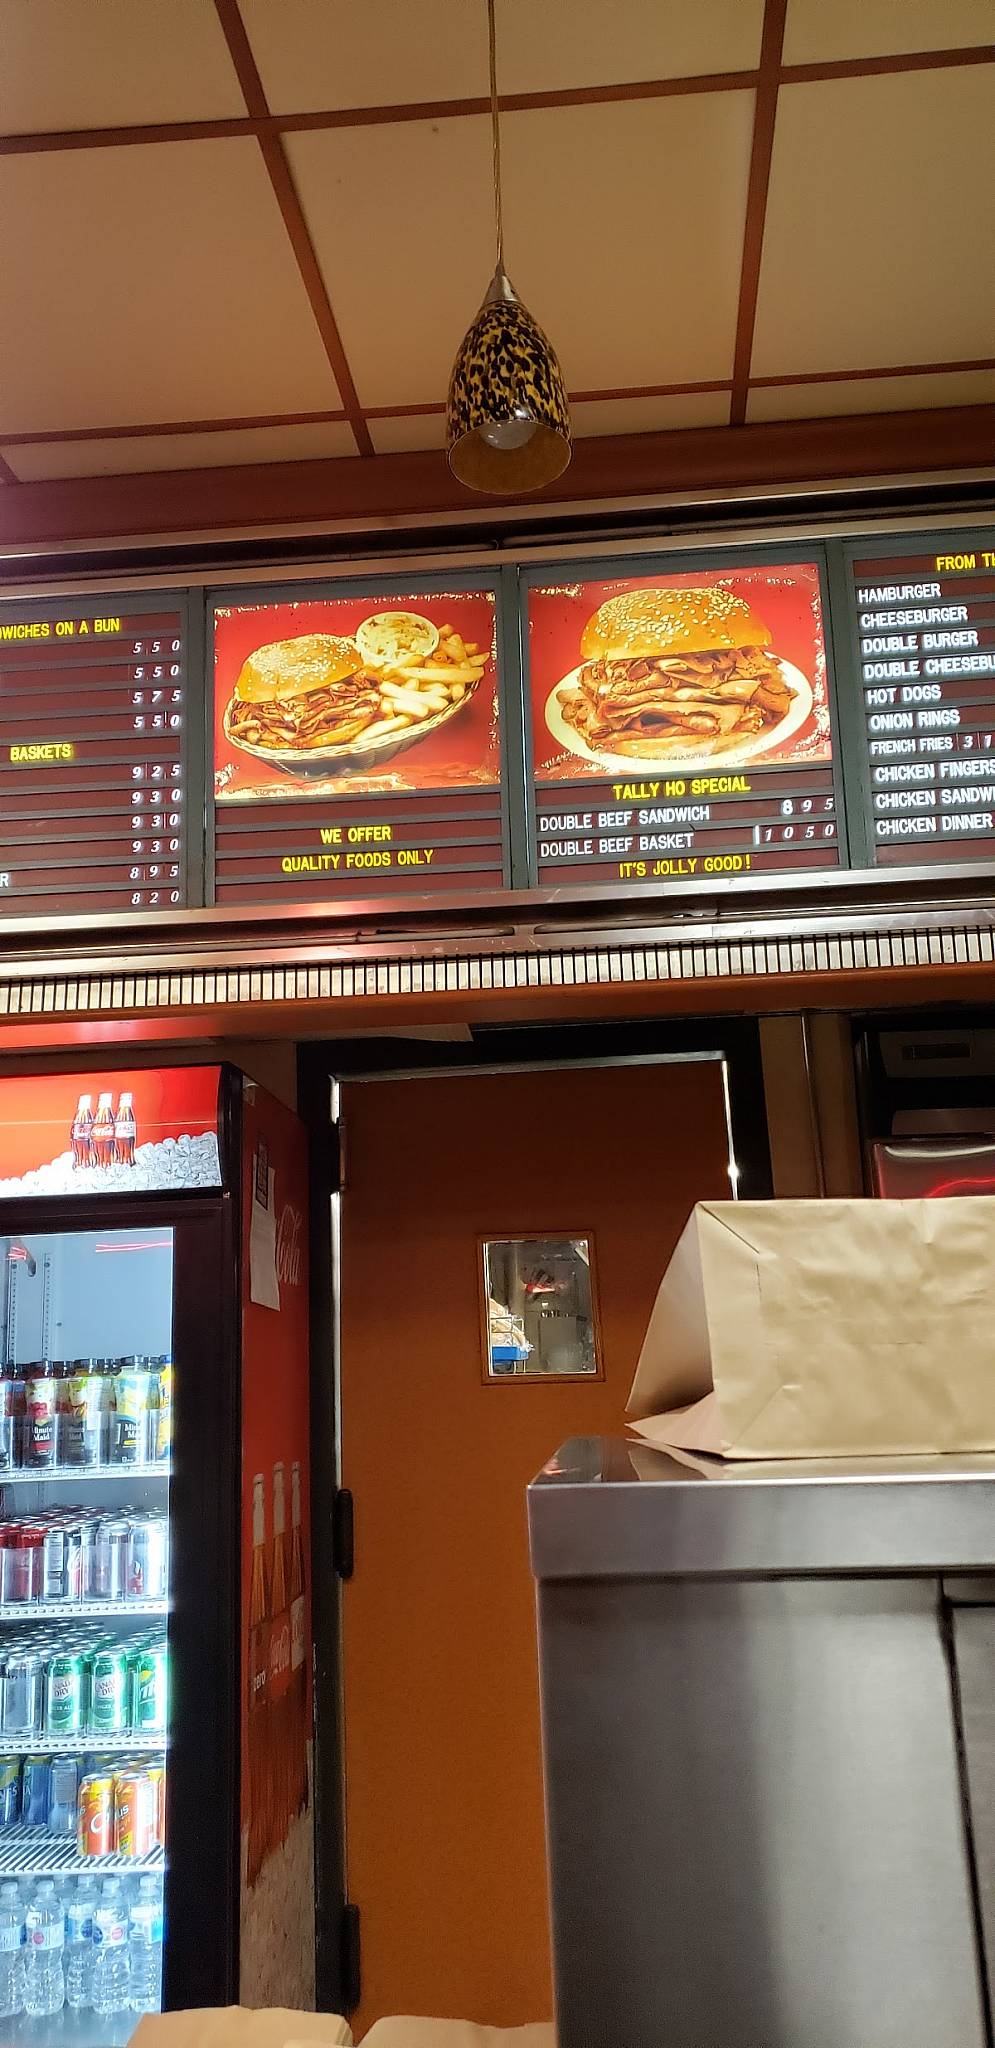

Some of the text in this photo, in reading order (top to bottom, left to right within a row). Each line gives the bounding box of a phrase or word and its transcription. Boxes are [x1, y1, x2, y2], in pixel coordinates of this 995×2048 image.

[936, 554, 976, 571] FROM
[858, 583, 941, 603] HAMBURGER
[56, 621, 73, 636] ON
[79, 620, 88, 634] A
[94, 618, 120, 633] BUN
[861, 606, 968, 628] CHEESEBURGER
[862, 630, 979, 654] DOUBLE BURGER
[863, 660, 920, 679] DOUBLE
[866, 685, 942, 704] HOT DOGS
[870, 709, 960, 730] ONION RINGS
[10, 743, 72, 761] BASKETS
[870, 739, 916, 755] FRENCH
[920, 736, 954, 752] FRIES
[875, 763, 936, 782] CHICKEN
[613, 776, 752, 800] TALLY HO SPECIAL
[876, 790, 937, 809] CHICKEN
[540, 813, 592, 832] DOUBLE
[598, 811, 633, 828] BEEF
[639, 805, 710, 825] SANDWICH
[876, 813, 994, 835] CHICKEN DINNER
[320, 826, 391, 844] WE OFFER
[541, 840, 593, 858] DOUBLE
[599, 837, 633, 854] BEEF
[640, 833, 694, 851] BASKET
[282, 849, 434, 872] QUALITY FOODS ONLY
[620, 862, 647, 878] IT'S
[652, 858, 697, 876] JOLLY
